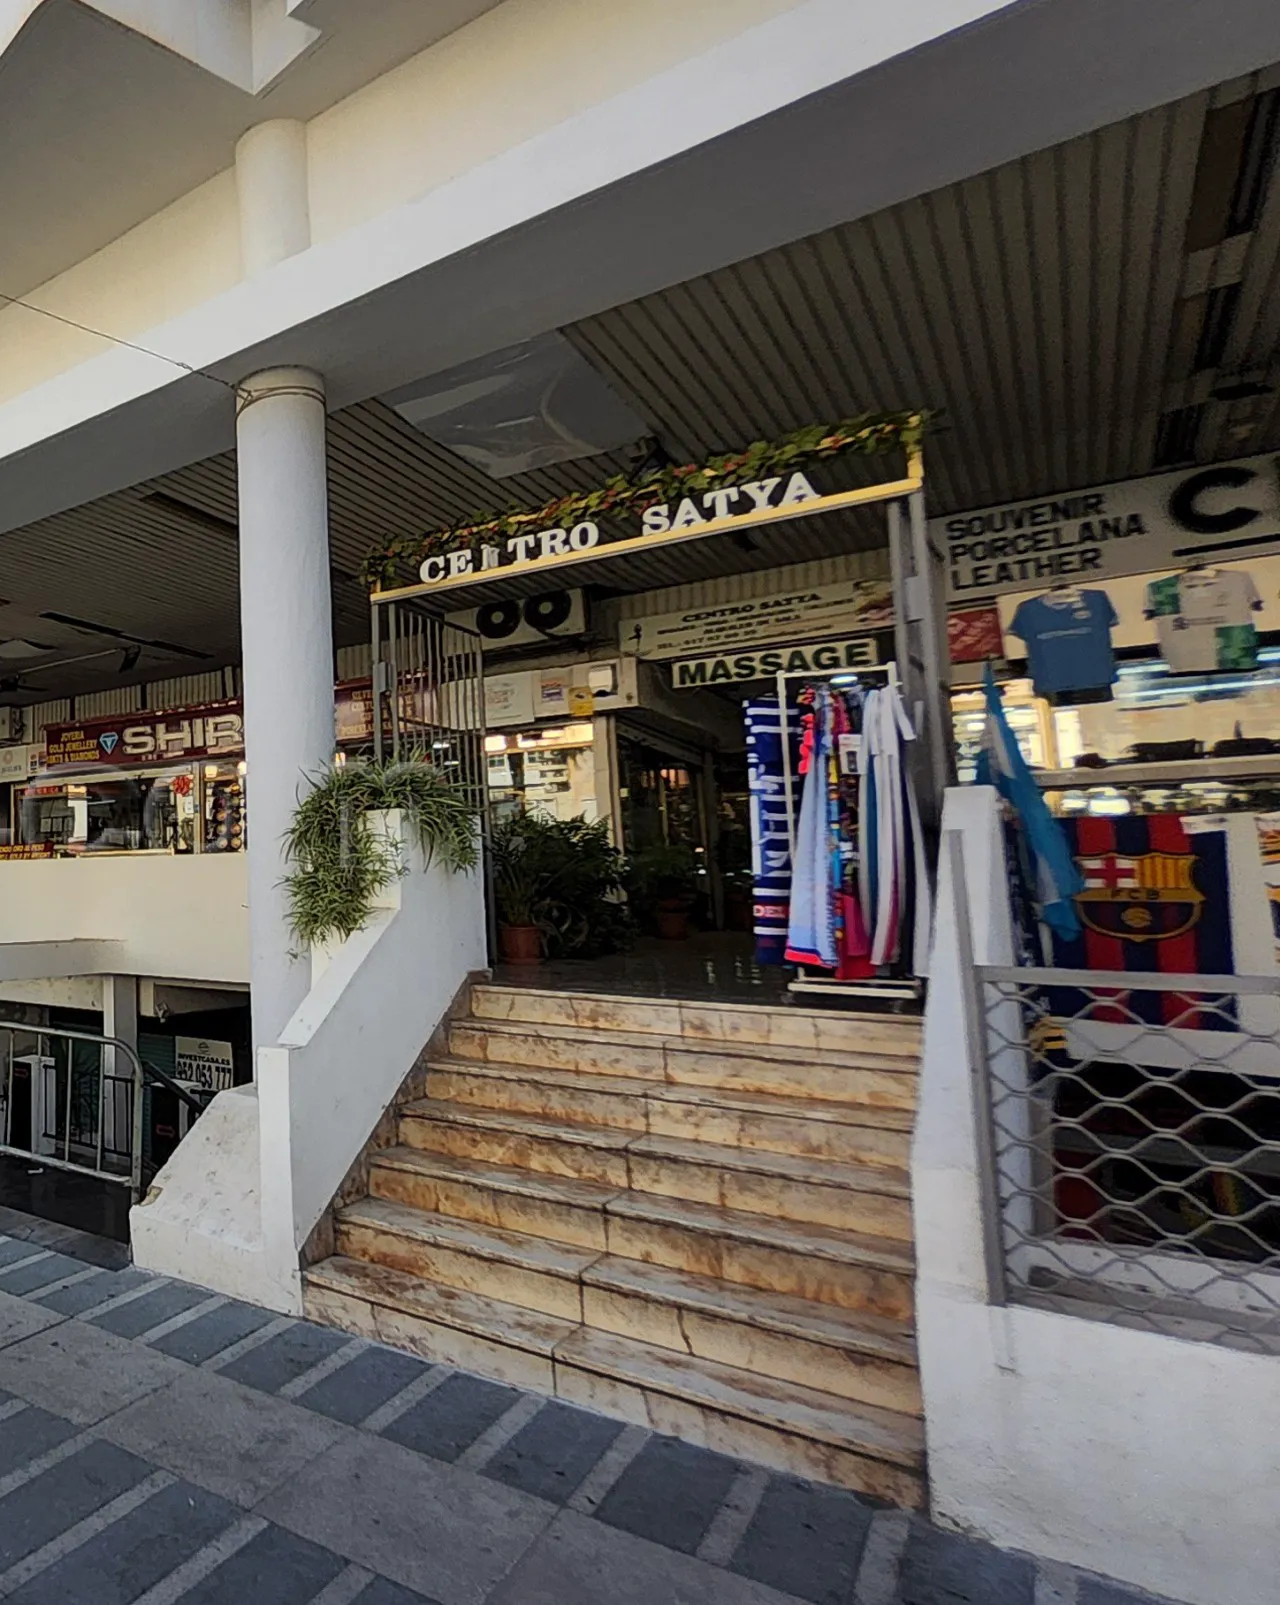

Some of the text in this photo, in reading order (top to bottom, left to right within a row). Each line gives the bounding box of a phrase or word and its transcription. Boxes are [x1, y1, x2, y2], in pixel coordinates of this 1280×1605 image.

[642, 472, 821, 536] SATYA
[946, 493, 1106, 540] SOUVENIR
[950, 513, 1148, 565] PORCELANA
[951, 548, 1103, 590] LEATHER
[678, 642, 872, 686] MASSAGE
[215, 1066, 232, 1089] 777
